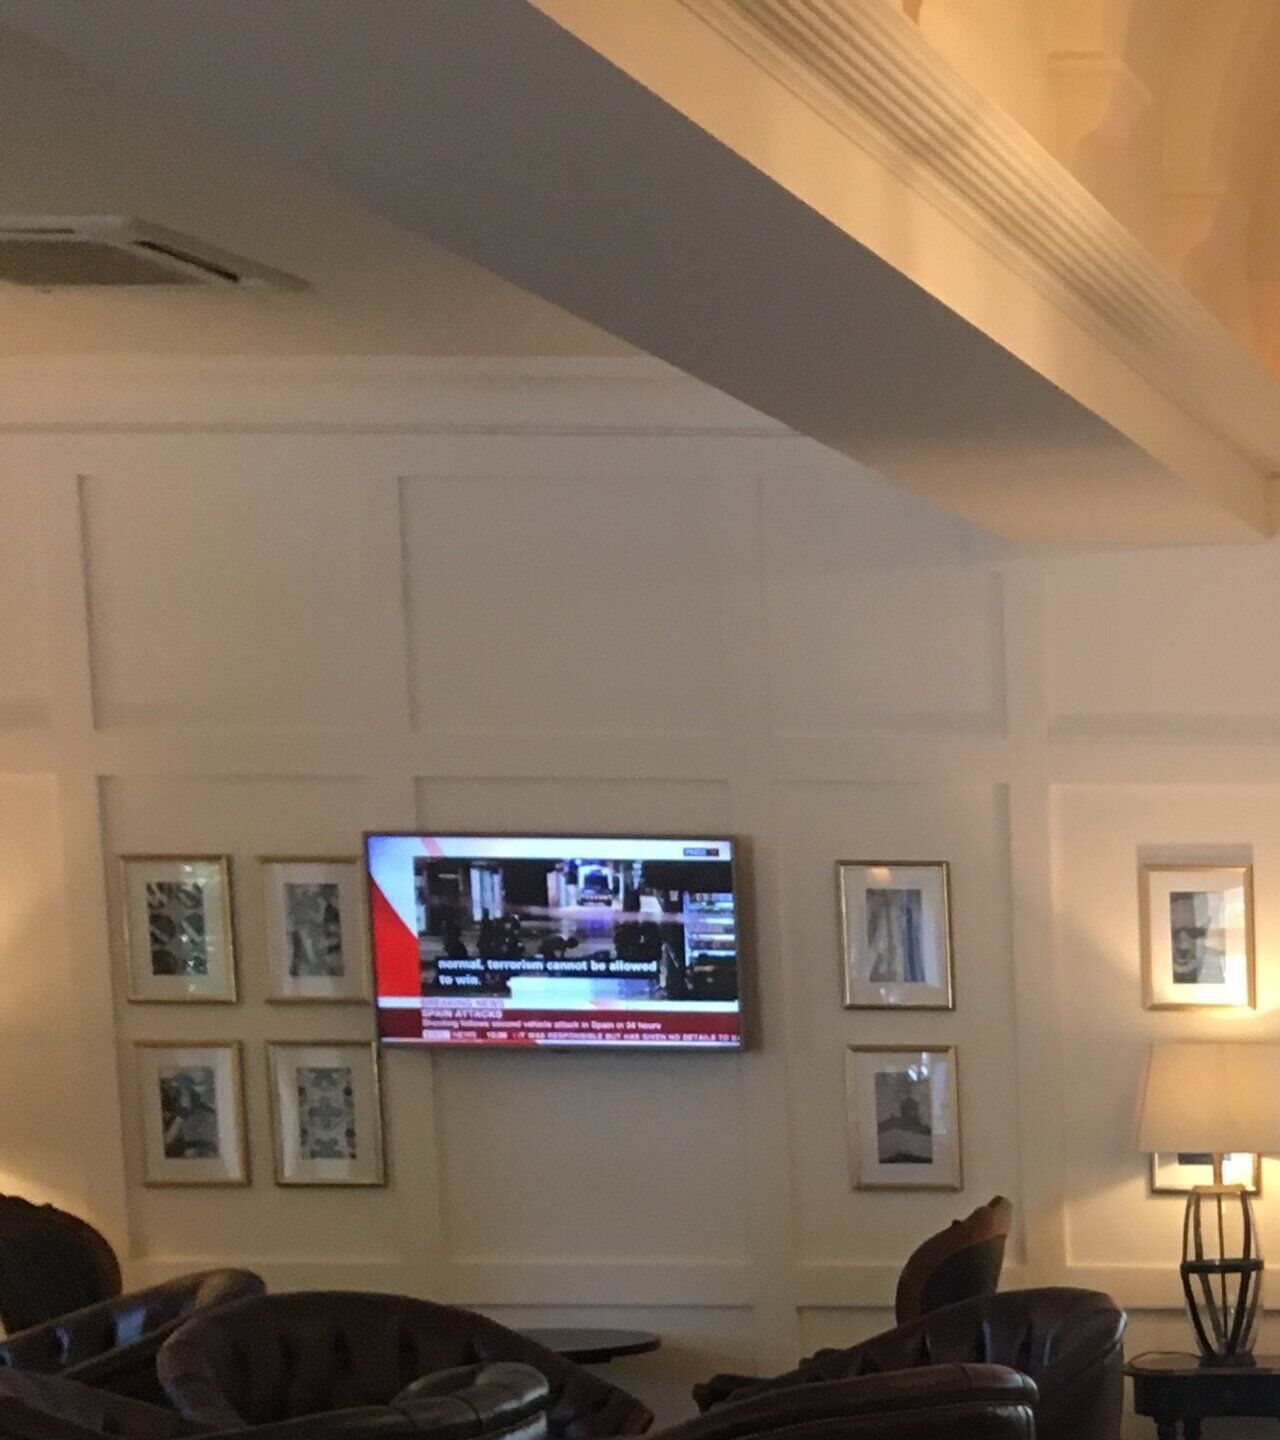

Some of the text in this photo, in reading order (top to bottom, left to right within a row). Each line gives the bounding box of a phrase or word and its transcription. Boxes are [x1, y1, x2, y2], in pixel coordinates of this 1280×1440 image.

[437, 959, 657, 972] normal, terrorism cannot be allowed
[438, 975, 453, 985] to
[421, 1009, 503, 1019] SPAIN ATTACKS
[591, 1021, 614, 1030] Spain
[638, 1021, 661, 1030] hours
